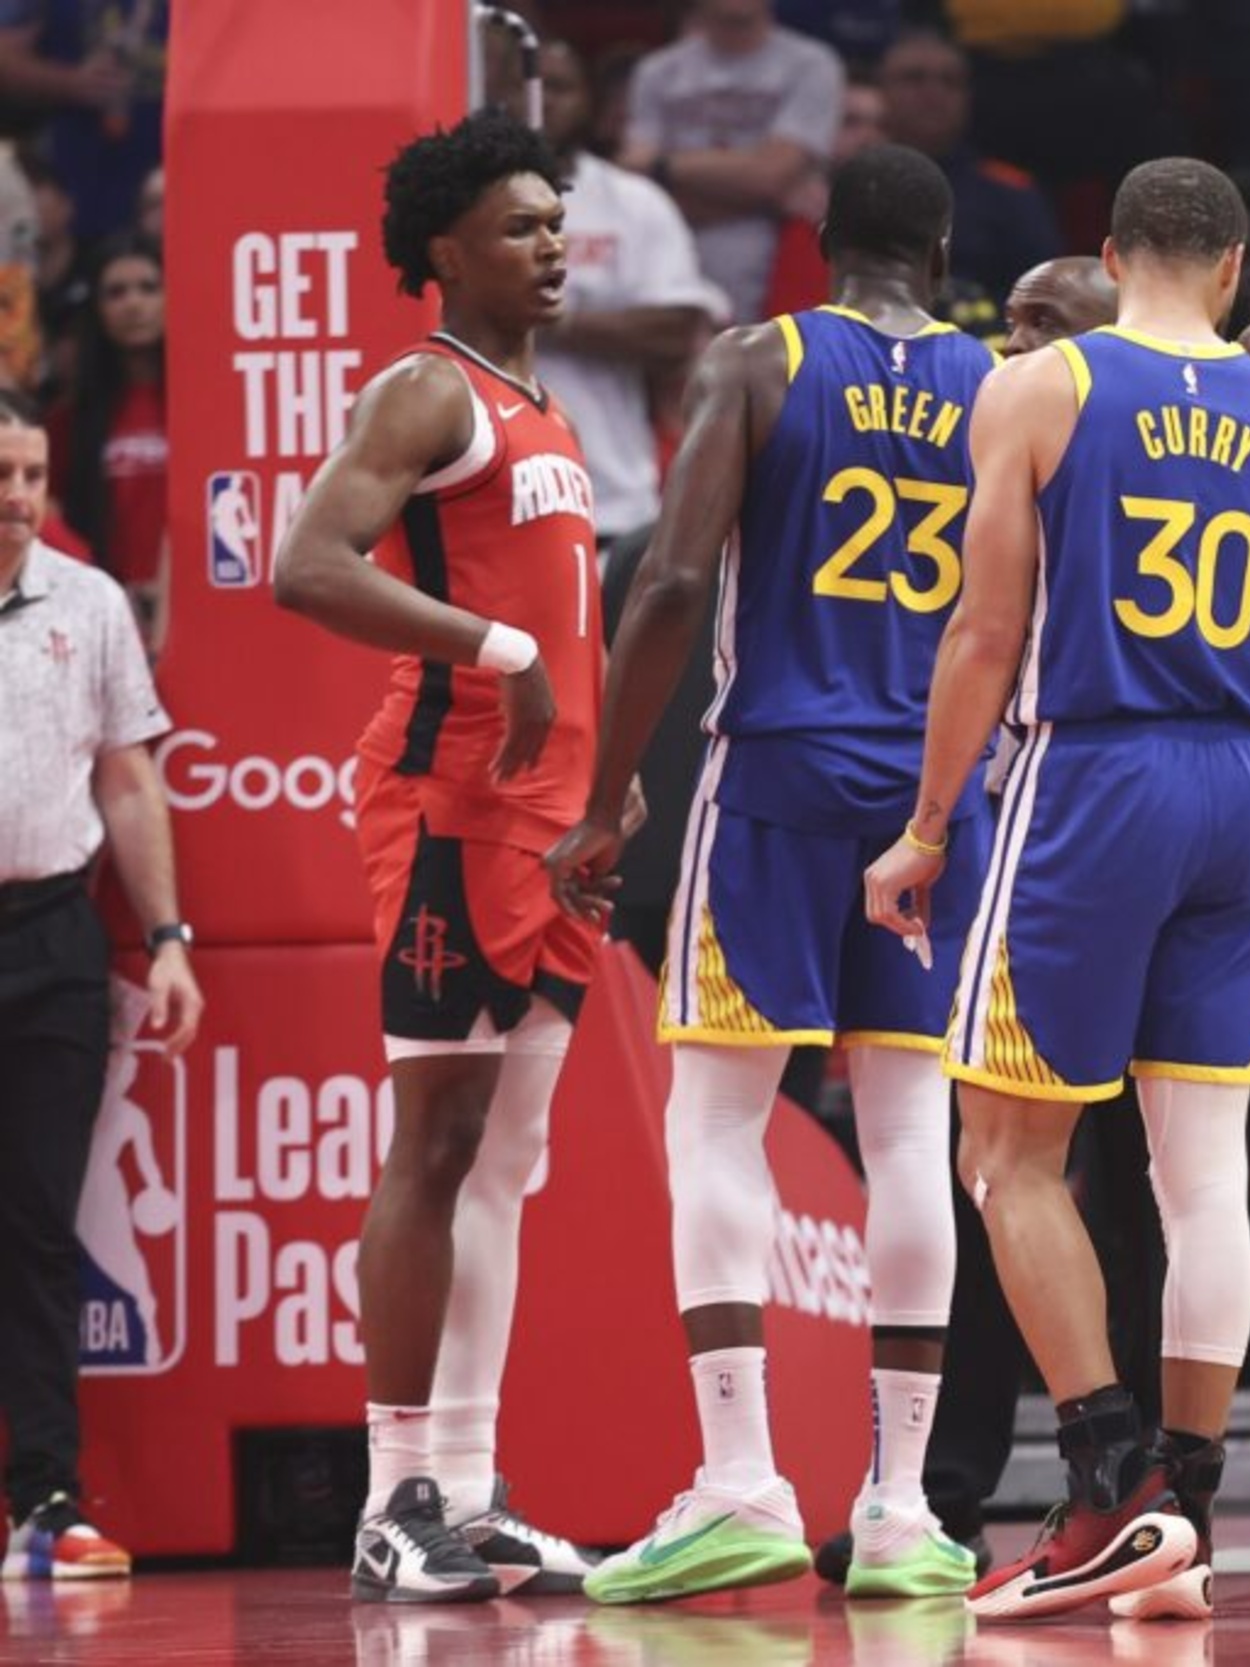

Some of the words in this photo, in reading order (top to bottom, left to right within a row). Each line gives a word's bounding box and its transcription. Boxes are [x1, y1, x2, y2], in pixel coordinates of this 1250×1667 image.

[233, 231, 358, 341] GET
[233, 350, 362, 458] THE
[844, 383, 963, 448] GREEN
[573, 542, 588, 638] 1
[813, 466, 968, 613] 23
[79, 1301, 129, 1351] BA
[215, 1211, 366, 1366] Pas
